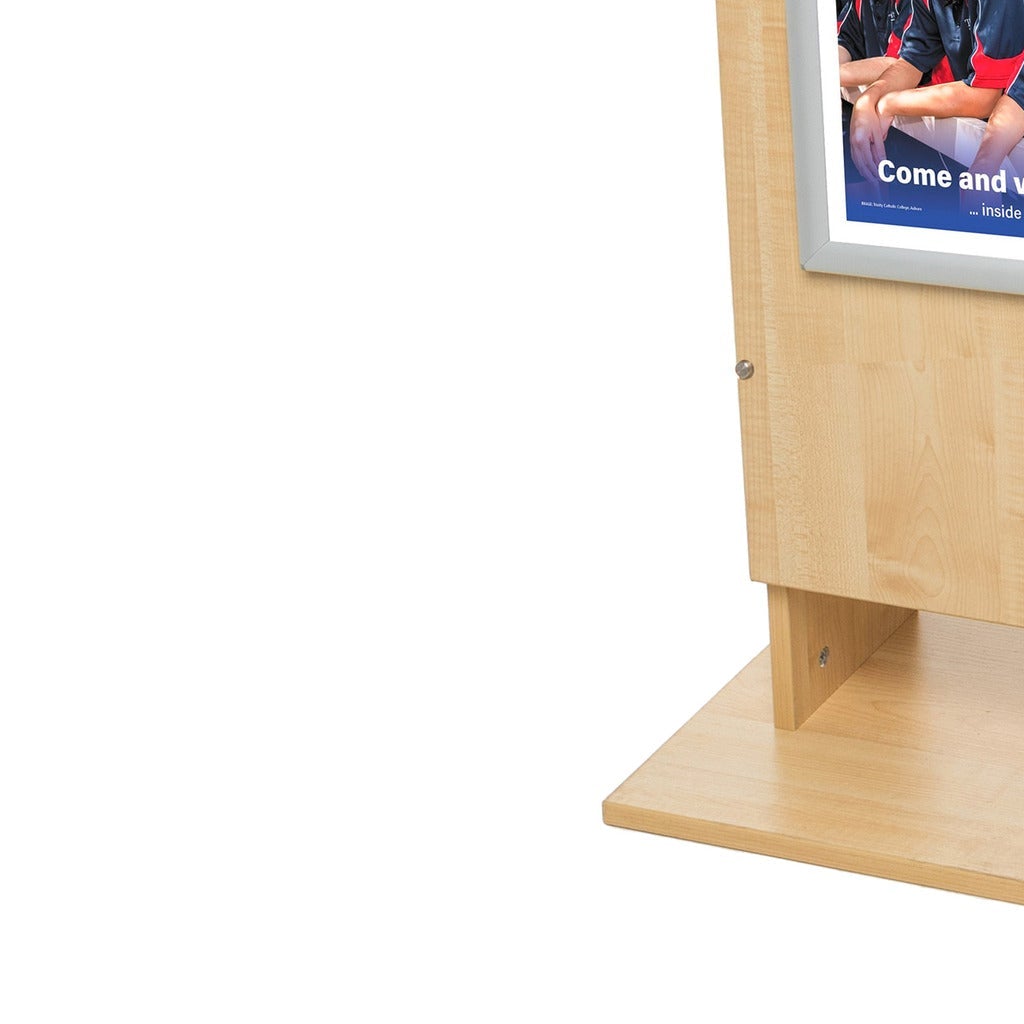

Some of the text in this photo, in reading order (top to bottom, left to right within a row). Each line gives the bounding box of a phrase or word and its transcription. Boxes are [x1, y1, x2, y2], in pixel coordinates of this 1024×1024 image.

[878, 159, 952, 188] Come
[959, 169, 1007, 193] and
[982, 202, 1022, 220] inside
